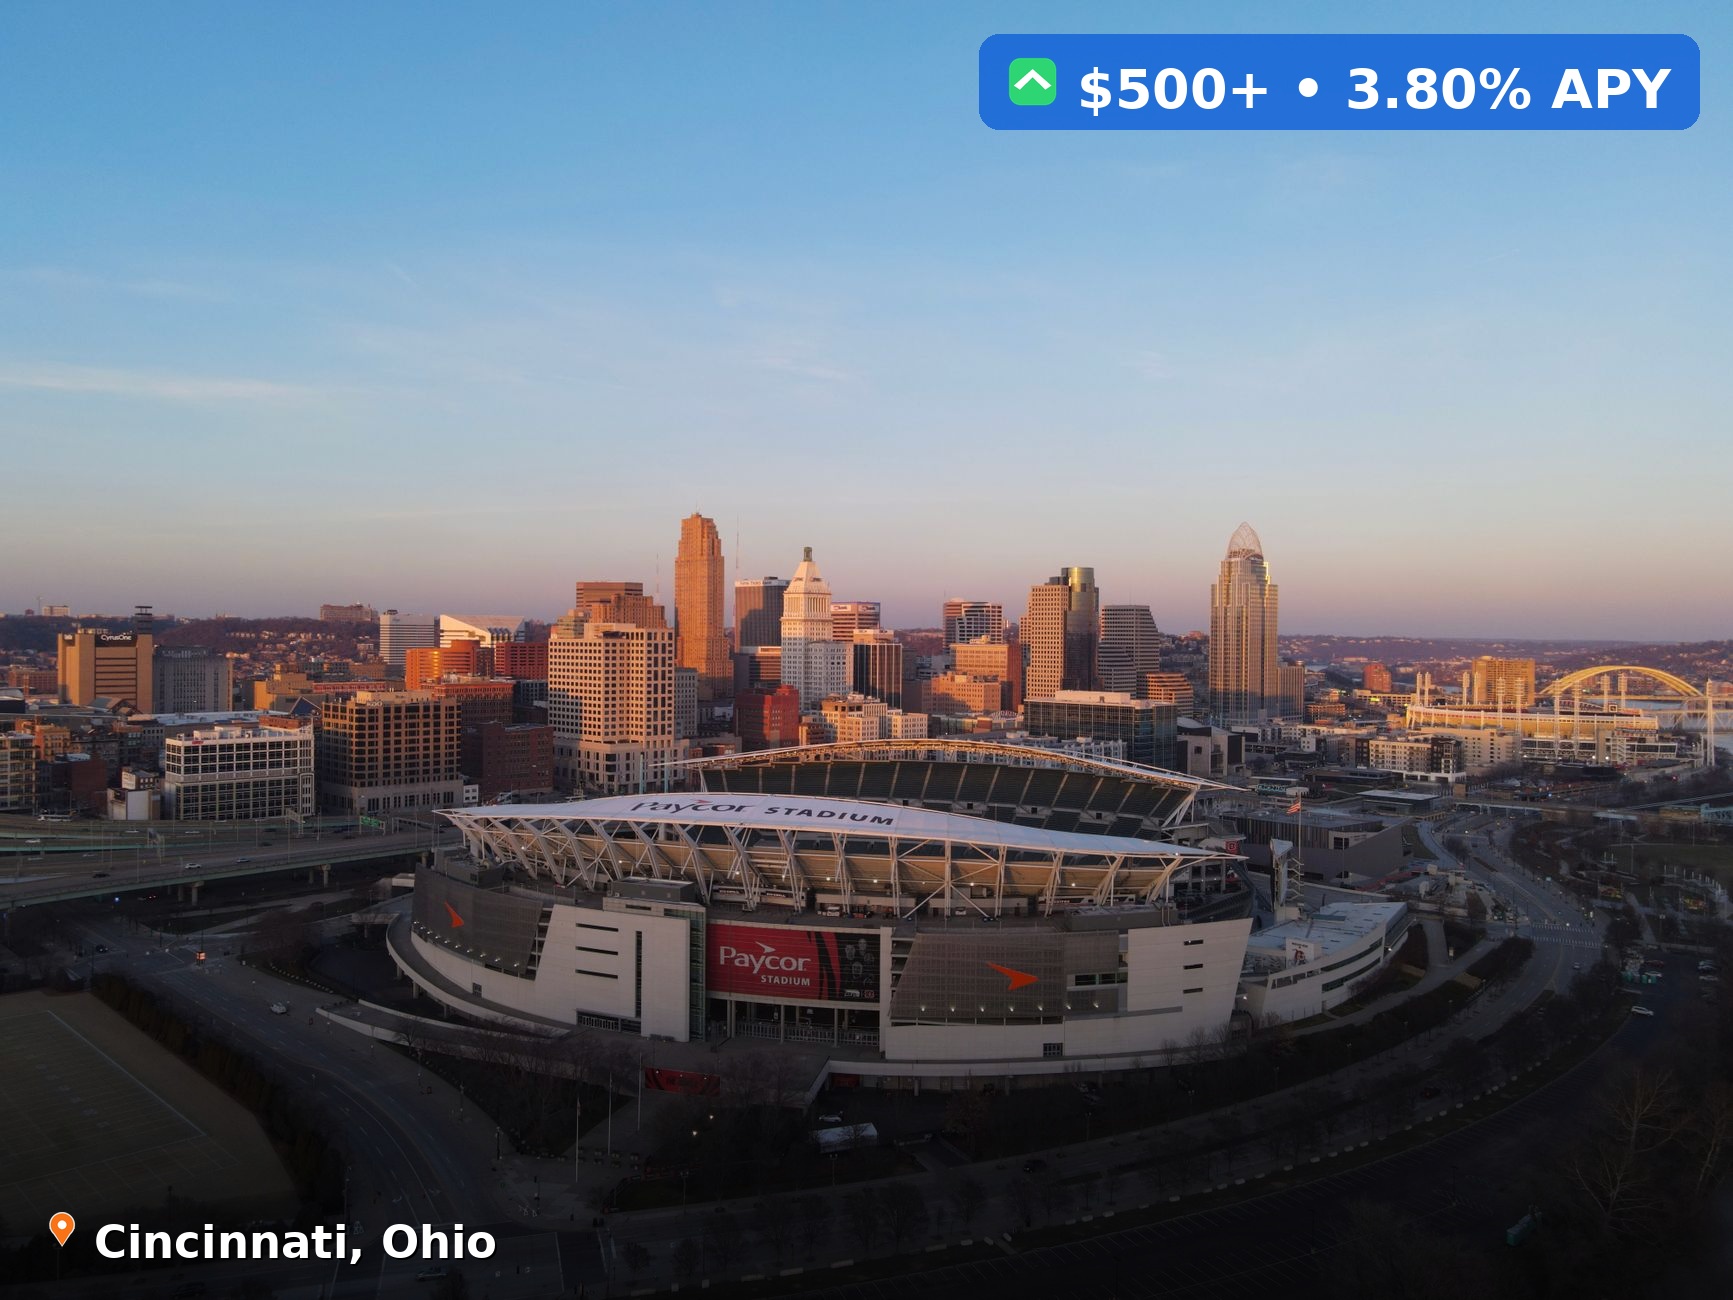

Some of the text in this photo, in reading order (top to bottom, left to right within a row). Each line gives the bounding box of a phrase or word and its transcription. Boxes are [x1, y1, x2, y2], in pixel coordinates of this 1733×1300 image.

[100, 633, 132, 641] CyrusOne
[631, 801, 893, 826] Paycor STADIUM
[719, 946, 812, 975] Paycor
[761, 975, 811, 986] STADIUM
